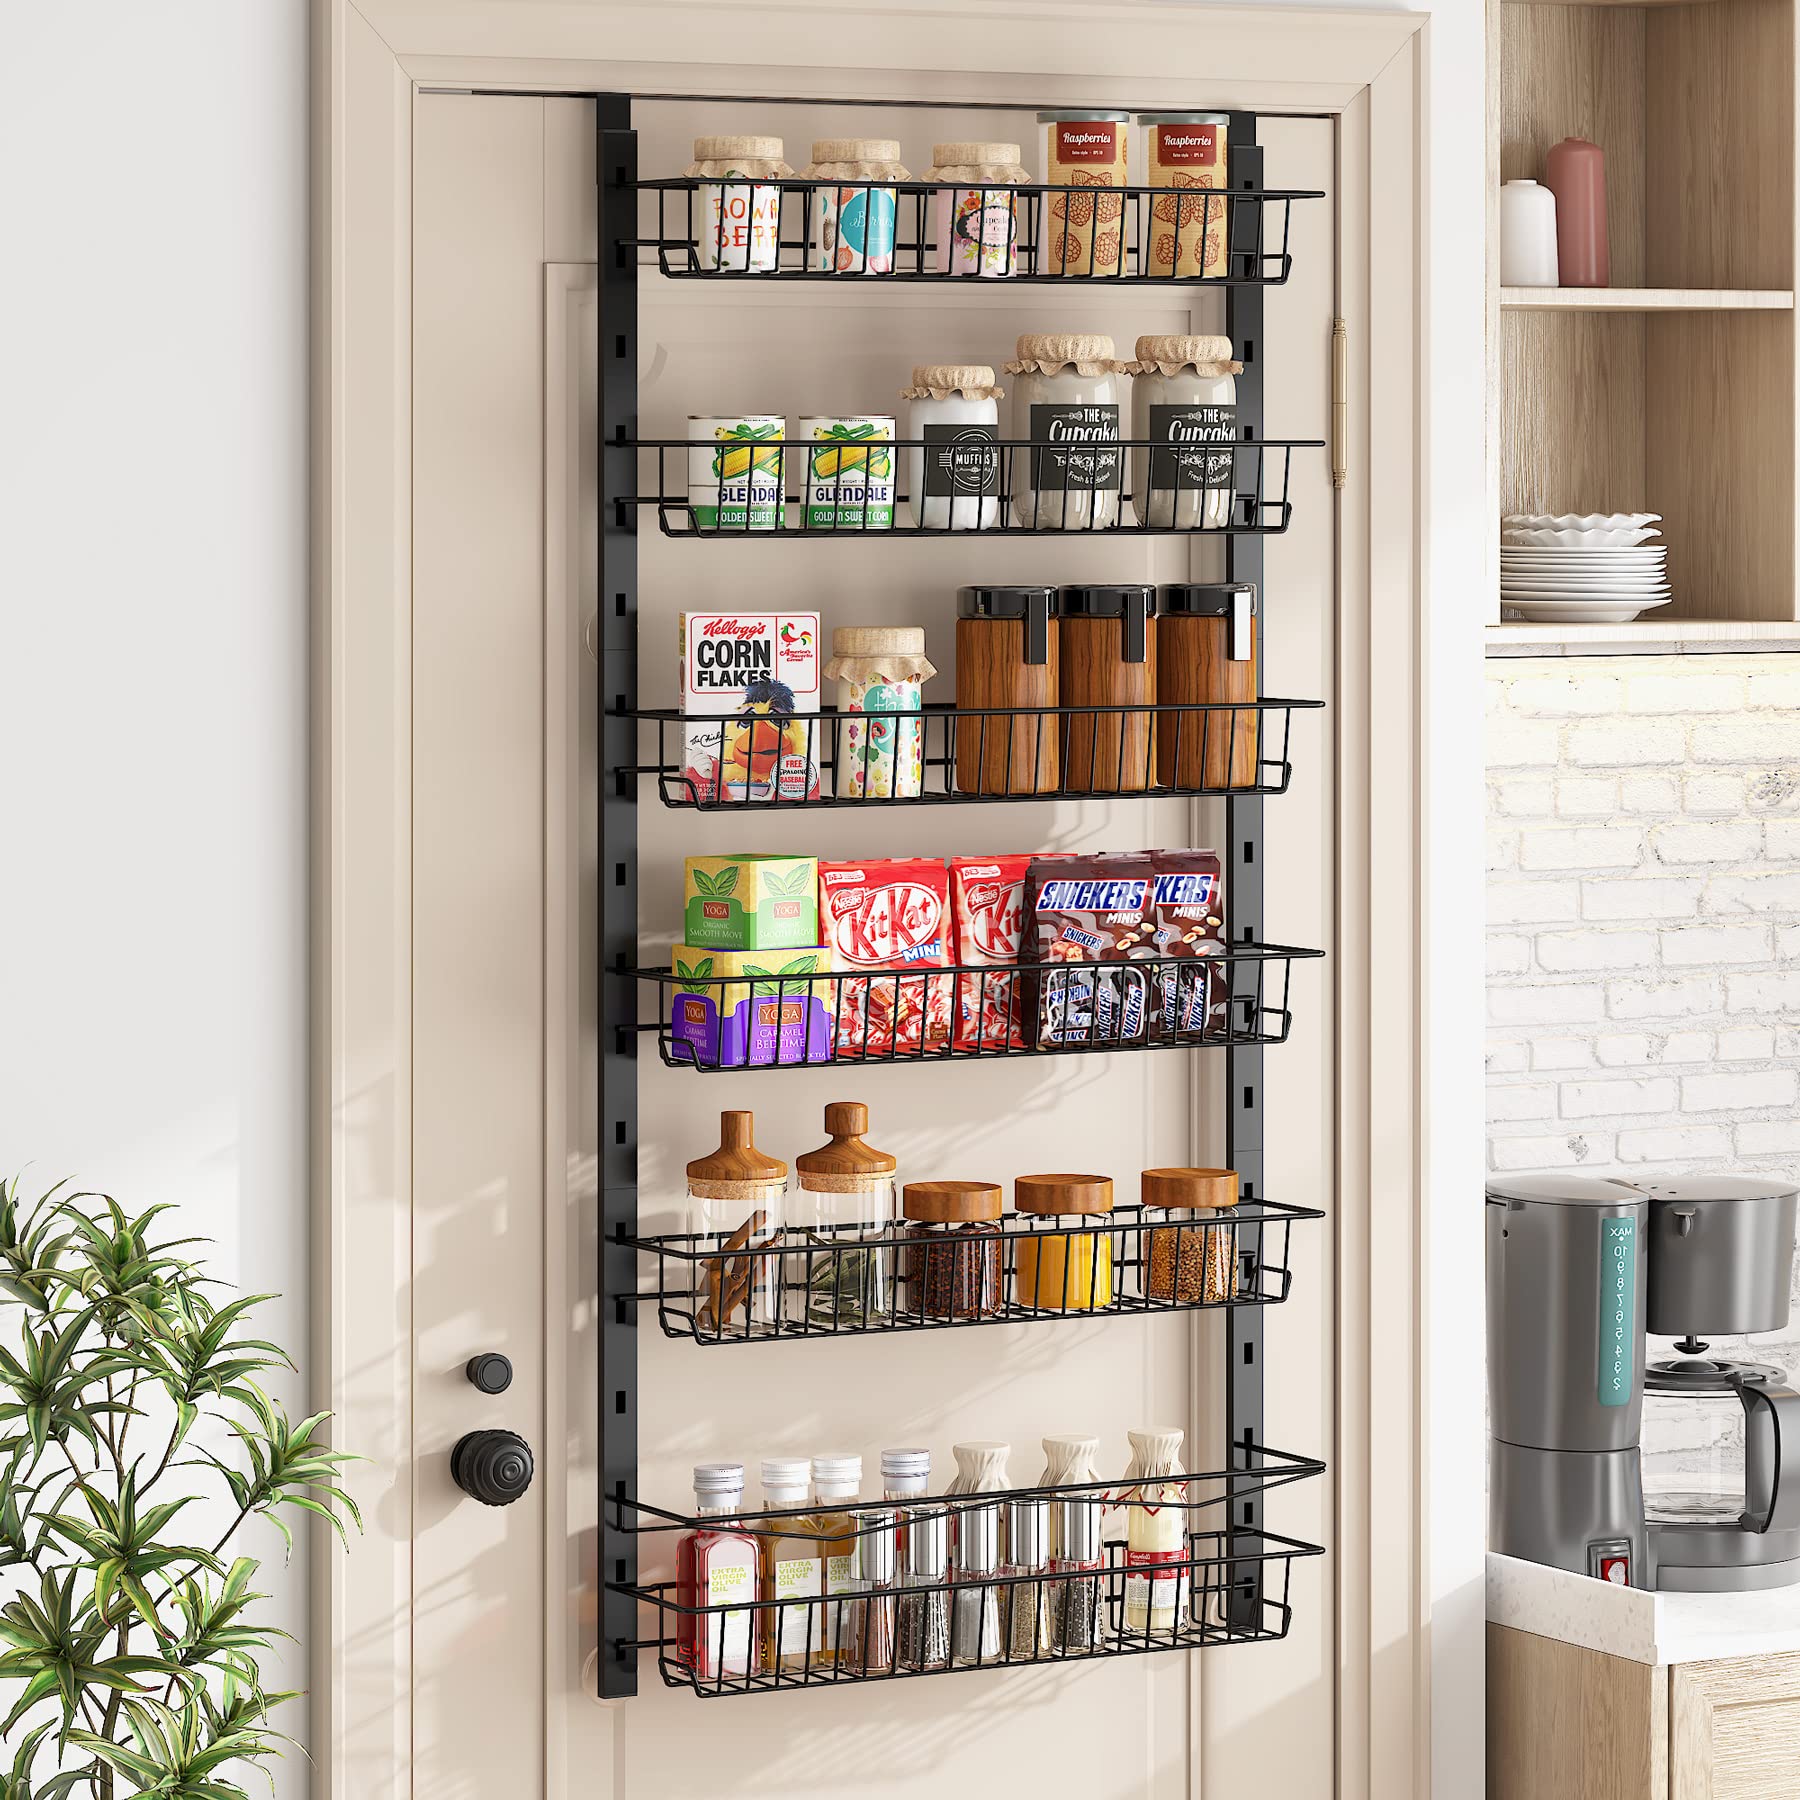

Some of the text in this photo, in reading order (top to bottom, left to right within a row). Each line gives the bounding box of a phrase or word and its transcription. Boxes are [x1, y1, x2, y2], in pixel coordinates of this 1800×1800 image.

[1062, 131, 1111, 146] Raspberries
[1163, 134, 1212, 149] Raspberries
[1083, 408, 1100, 423] THE
[1202, 408, 1219, 423] THE
[955, 453, 990, 465] MUFFIS
[1187, 470, 1204, 483] Fresh
[719, 487, 784, 502] GLENDAE
[813, 511, 843, 522] GOLDN
[844, 511, 872, 522] SWET
[703, 618, 767, 640] Kellogg's
[697, 640, 771, 669] CORN
[697, 670, 772, 687] FLAKES
[785, 759, 803, 768] FREE
[779, 776, 807, 784] BASEBAL
[1155, 875, 1211, 904] KERS
[1037, 881, 1146, 911] SNICKERS
[704, 904, 729, 916] YOGA
[775, 905, 800, 916] YOGA
[1172, 906, 1208, 918] MINIS
[1106, 911, 1142, 924] MINIS
[703, 920, 730, 930] ORGANIC
[689, 928, 743, 940] SMOOTH MOVE
[1063, 926, 1104, 950] SNICKERS
[1050, 984, 1092, 1004] NICKRS
[685, 1004, 705, 1019] YOGA
[762, 1007, 799, 1020] YOGA
[1098, 987, 1112, 1039] SNICKERS
[759, 1028, 803, 1038] CARAMEL
[756, 1038, 806, 1050] BEDTIME
[735, 1054, 765, 1062] SPEIALLY
[711, 1566, 745, 1575] EXTRA
[778, 1560, 812, 1569] EXTRA
[778, 1566, 813, 1575] VIRGIN
[711, 1572, 747, 1581] VIRGIN
[711, 1578, 743, 1587] OLIVE
[778, 1573, 809, 1581] OLIVE
[711, 1585, 729, 1593] OIL
